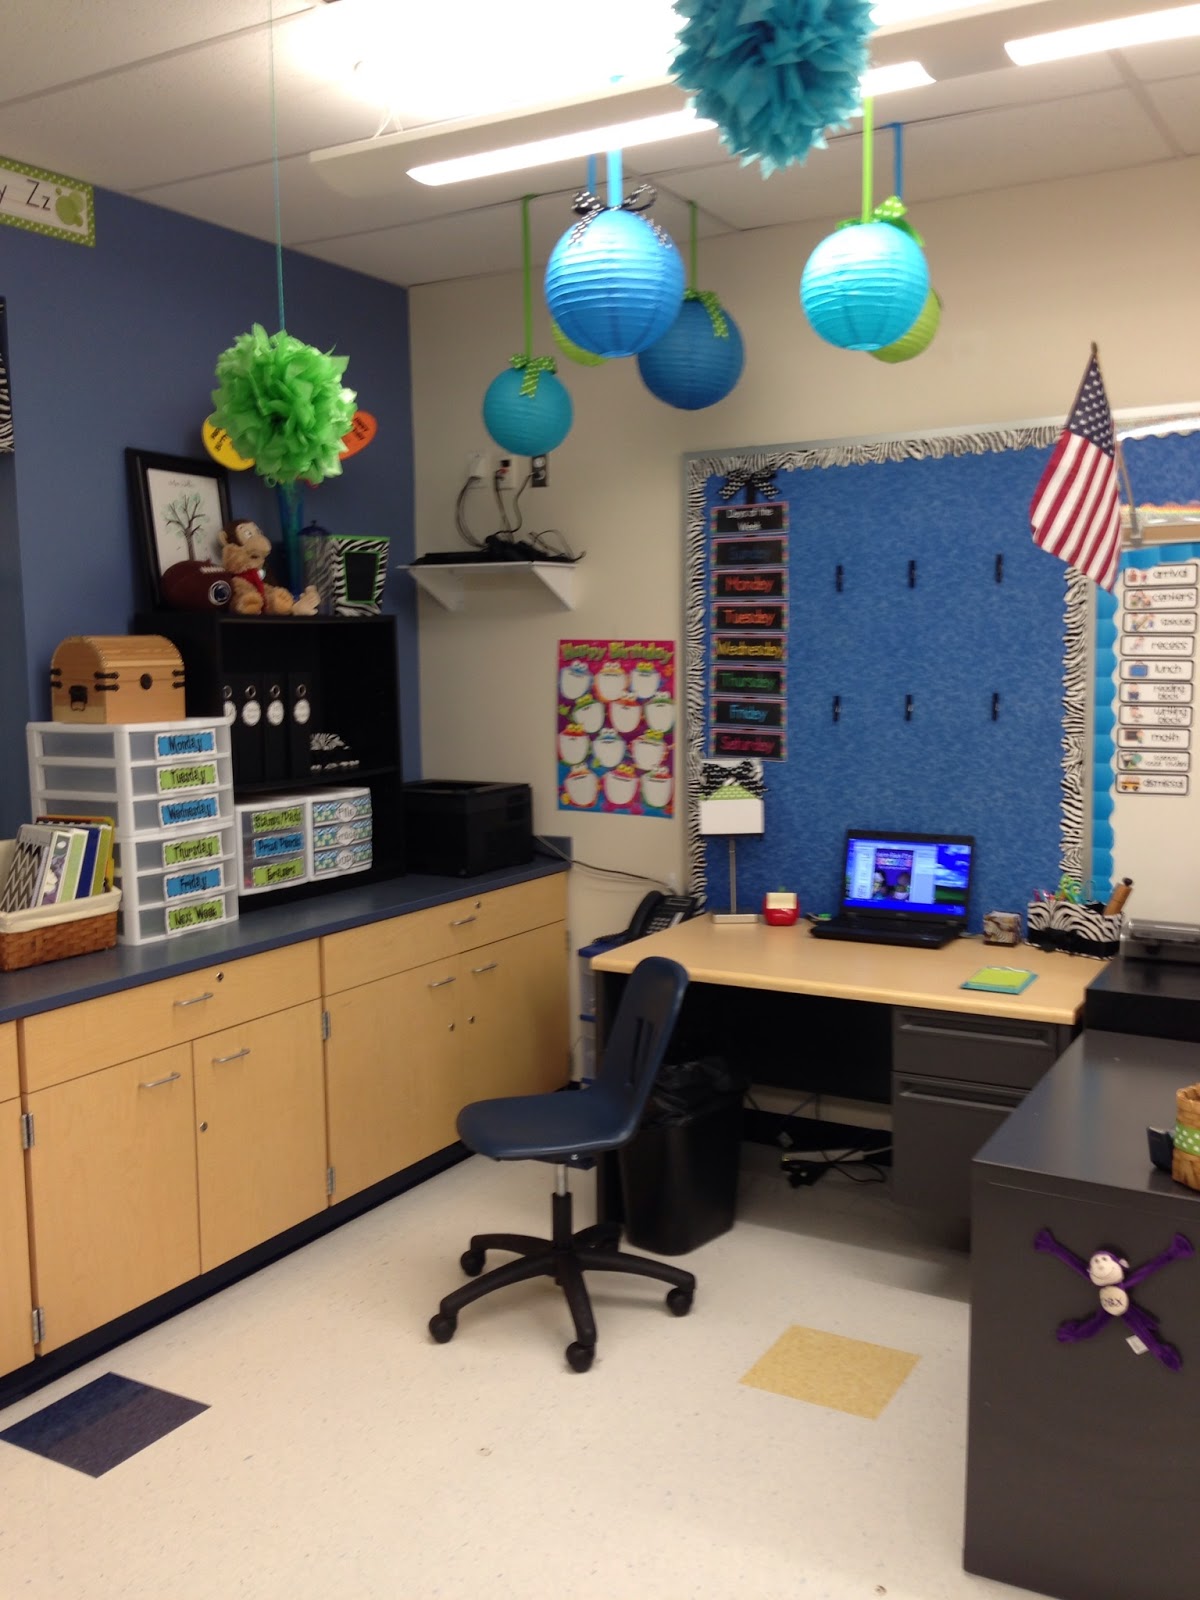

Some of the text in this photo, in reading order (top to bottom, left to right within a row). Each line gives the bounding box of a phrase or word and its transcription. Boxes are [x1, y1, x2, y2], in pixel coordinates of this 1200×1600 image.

[26, 179, 51, 211] Zz
[725, 576, 775, 593] Monday
[722, 609, 776, 627] Tuesday
[718, 640, 783, 659] Wednesday
[1155, 664, 1182, 674] lunch
[720, 672, 776, 691] Thursday
[730, 704, 769, 722] Friday
[168, 736, 202, 752] Monday
[720, 735, 775, 754] Saturday
[171, 768, 206, 785] Tuesday
[167, 801, 211, 819] Wednesday
[173, 841, 213, 860] Thursday
[180, 874, 207, 890] Friday
[174, 906, 217, 925] Next Week
